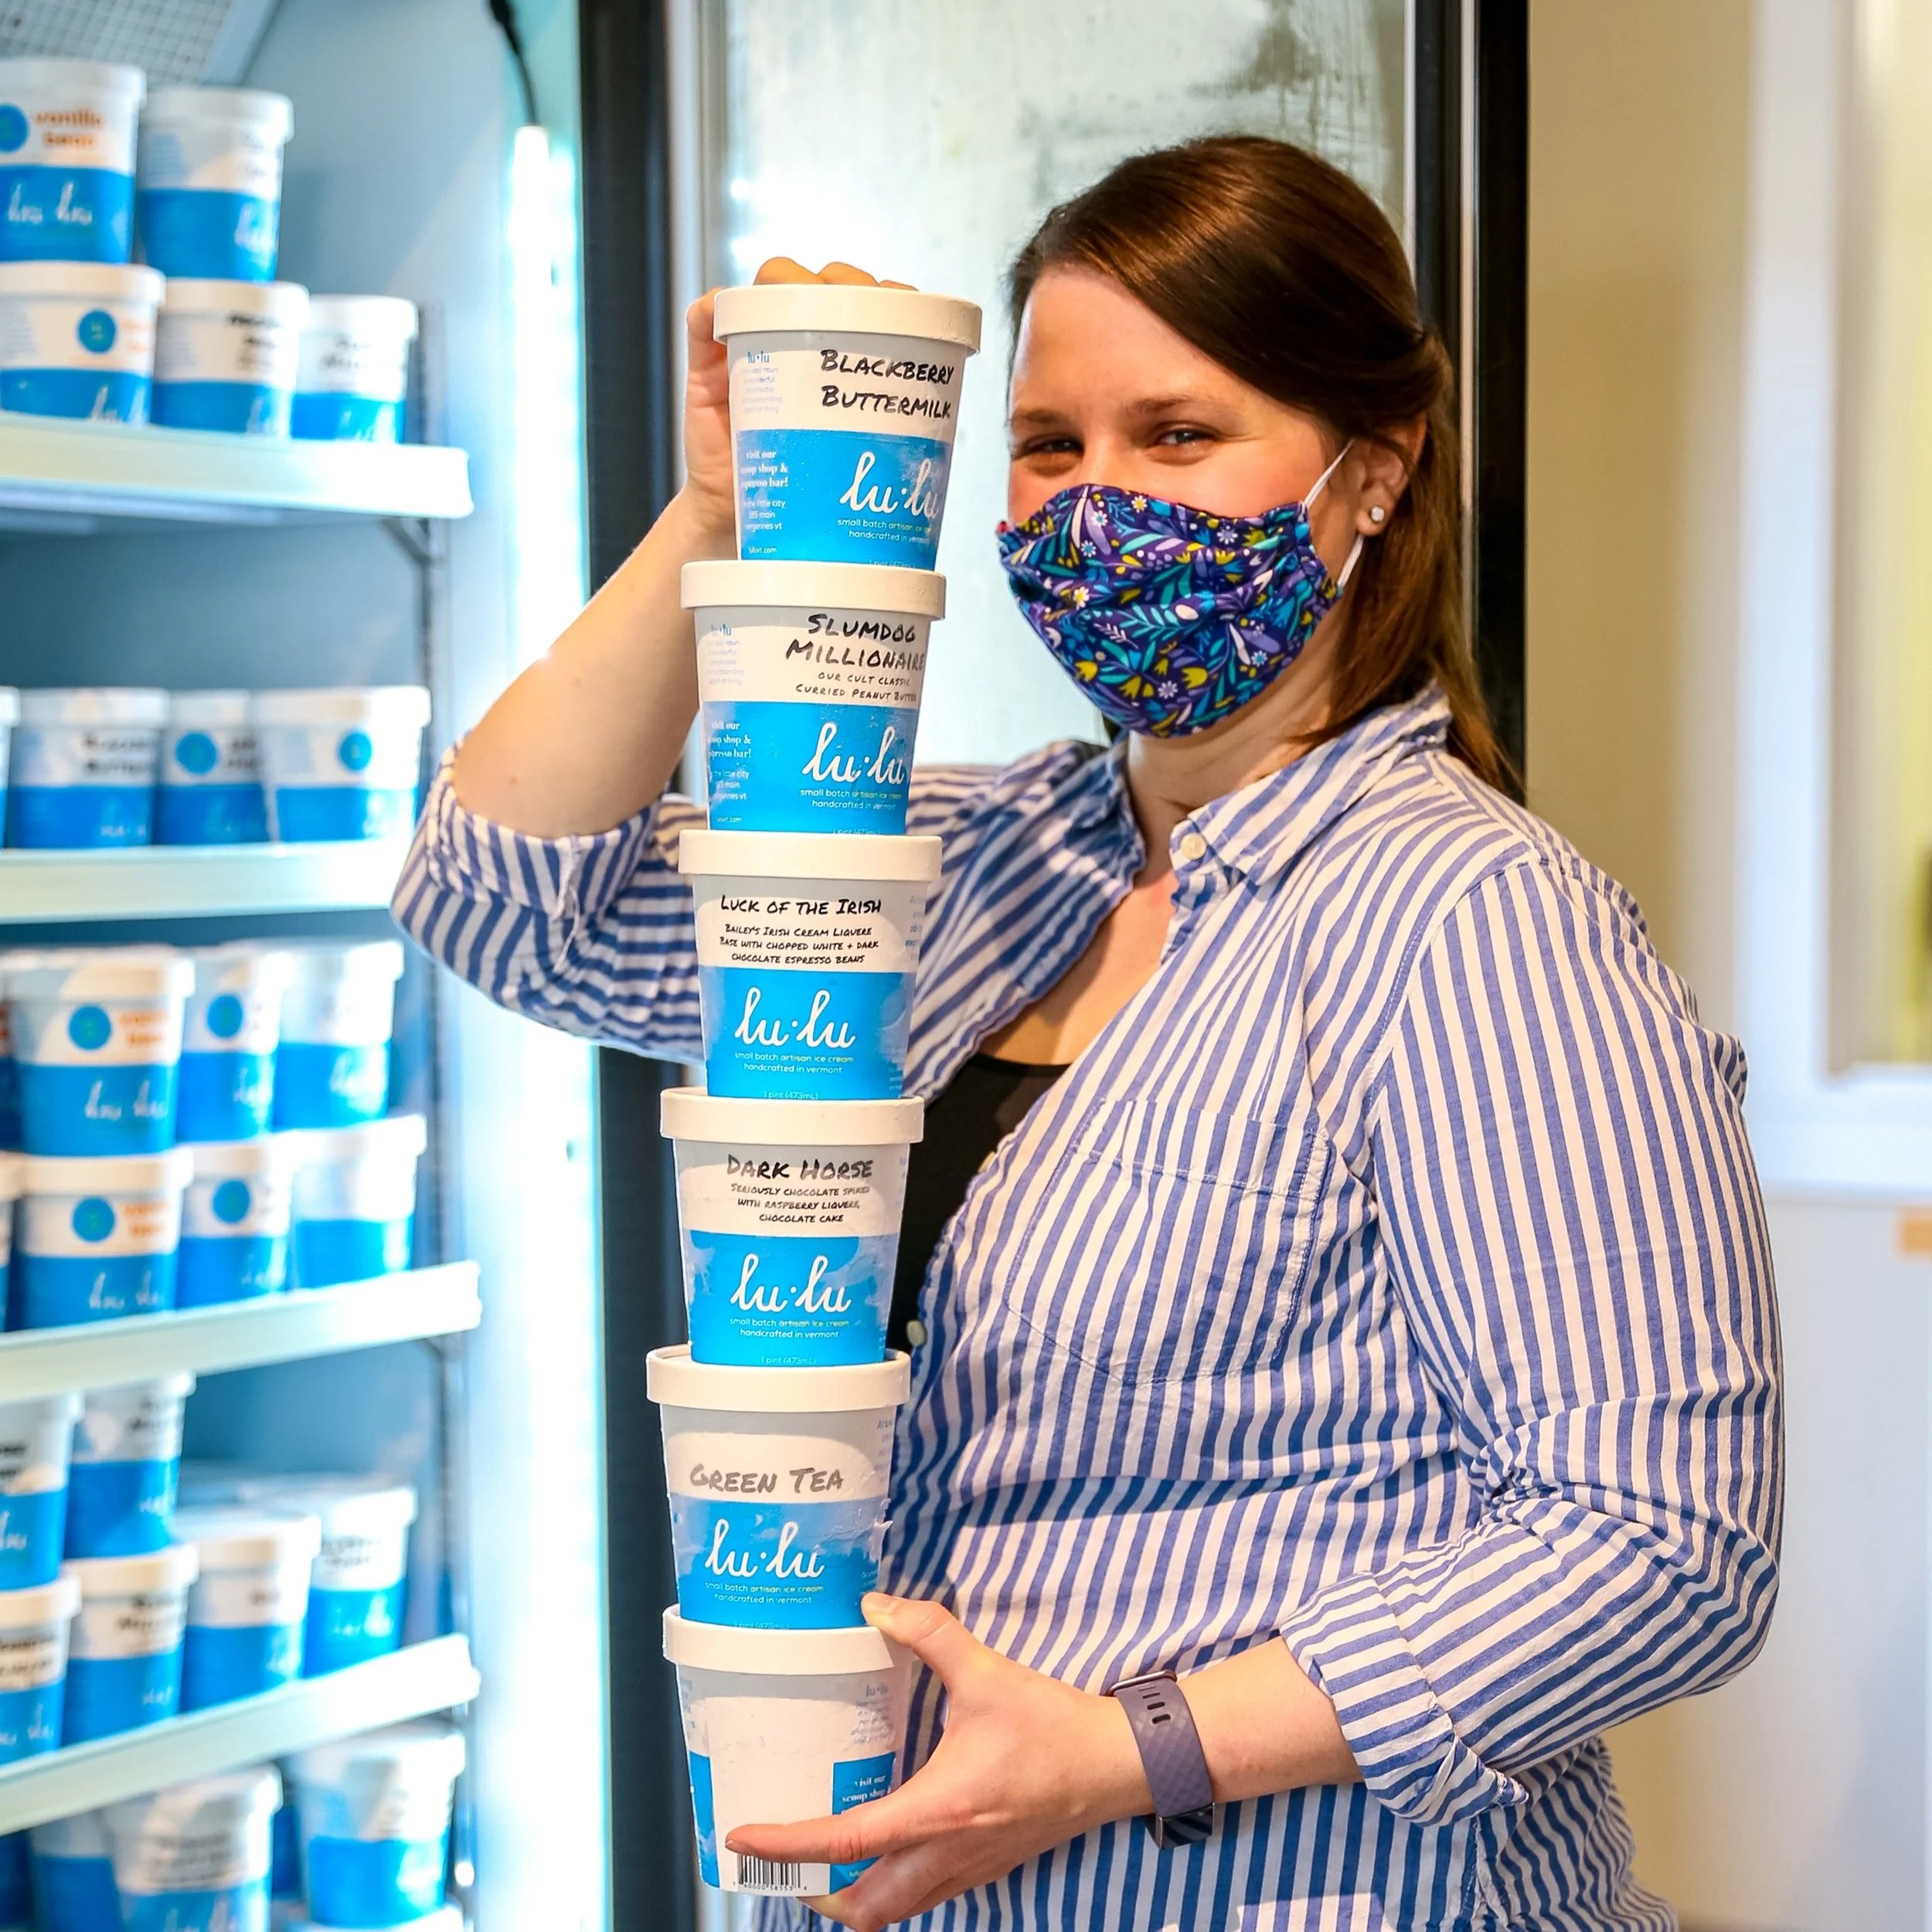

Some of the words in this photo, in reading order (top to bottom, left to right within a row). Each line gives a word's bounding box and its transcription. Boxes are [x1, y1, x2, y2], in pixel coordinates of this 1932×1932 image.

[821, 349, 955, 385] BLACKBERRY
[821, 386, 951, 418] BUTTERMILK
[862, 519, 886, 529] batch
[889, 522, 912, 531] artisan
[849, 530, 900, 541] handcrafted
[808, 614, 917, 643] SLUMDOG
[786, 639, 925, 672] MILLIONAIRE
[818, 672, 842, 682] OUR
[847, 675, 876, 684] CULT
[795, 684, 845, 697] CURRIED
[852, 689, 891, 700] PEANUT
[726, 722, 740, 730] our
[723, 733, 742, 747] shop
[744, 733, 752, 744] &
[733, 748, 752, 758] bar!
[825, 789, 850, 798] batch
[812, 800, 863, 809] handcrafted
[720, 895, 760, 913] LUCK
[767, 900, 791, 913] OF
[796, 902, 829, 915] THE
[835, 899, 882, 915] IRISH
[763, 927, 790, 937] IRISH
[794, 927, 829, 937] CREAM
[832, 927, 872, 937] LIQUERE
[719, 936, 737, 947] BASE
[740, 939, 763, 949] WITH
[766, 940, 808, 951] CHOPPED
[812, 941, 844, 951] WHITE
[857, 940, 879, 950] DARK
[731, 953, 781, 964] CHOCOLATE
[785, 954, 832, 964] ESPRESSO
[835, 954, 866, 964] BEANS
[754, 1053, 778, 1061] batch
[744, 1063, 794, 1072] handcrafted
[784, 1091, 819, 1100] (473mL)
[726, 1154, 790, 1179] DARK
[800, 1158, 874, 1180] HORSE
[731, 1183, 781, 1196] SERIOUSLY
[784, 1187, 839, 1196] CHOCOLATE
[842, 1186, 871, 1196] SPIKED
[737, 1199, 760, 1207] WITH
[764, 1200, 818, 1209] RASPBERRY
[759, 1214, 815, 1223] CHOCOLATE
[819, 1214, 844, 1223] CAKE
[752, 1318, 777, 1327] batch
[740, 1328, 793, 1338] handcrafted
[783, 1356, 816, 1365] (473mL)
[689, 1463, 777, 1493] GREEN
[789, 1466, 845, 1493] TEA
[725, 1583, 748, 1592] batch
[714, 1594, 764, 1604] handcrafted
[854, 1777, 872, 1787] visit
[842, 1793, 868, 1803] scoop
